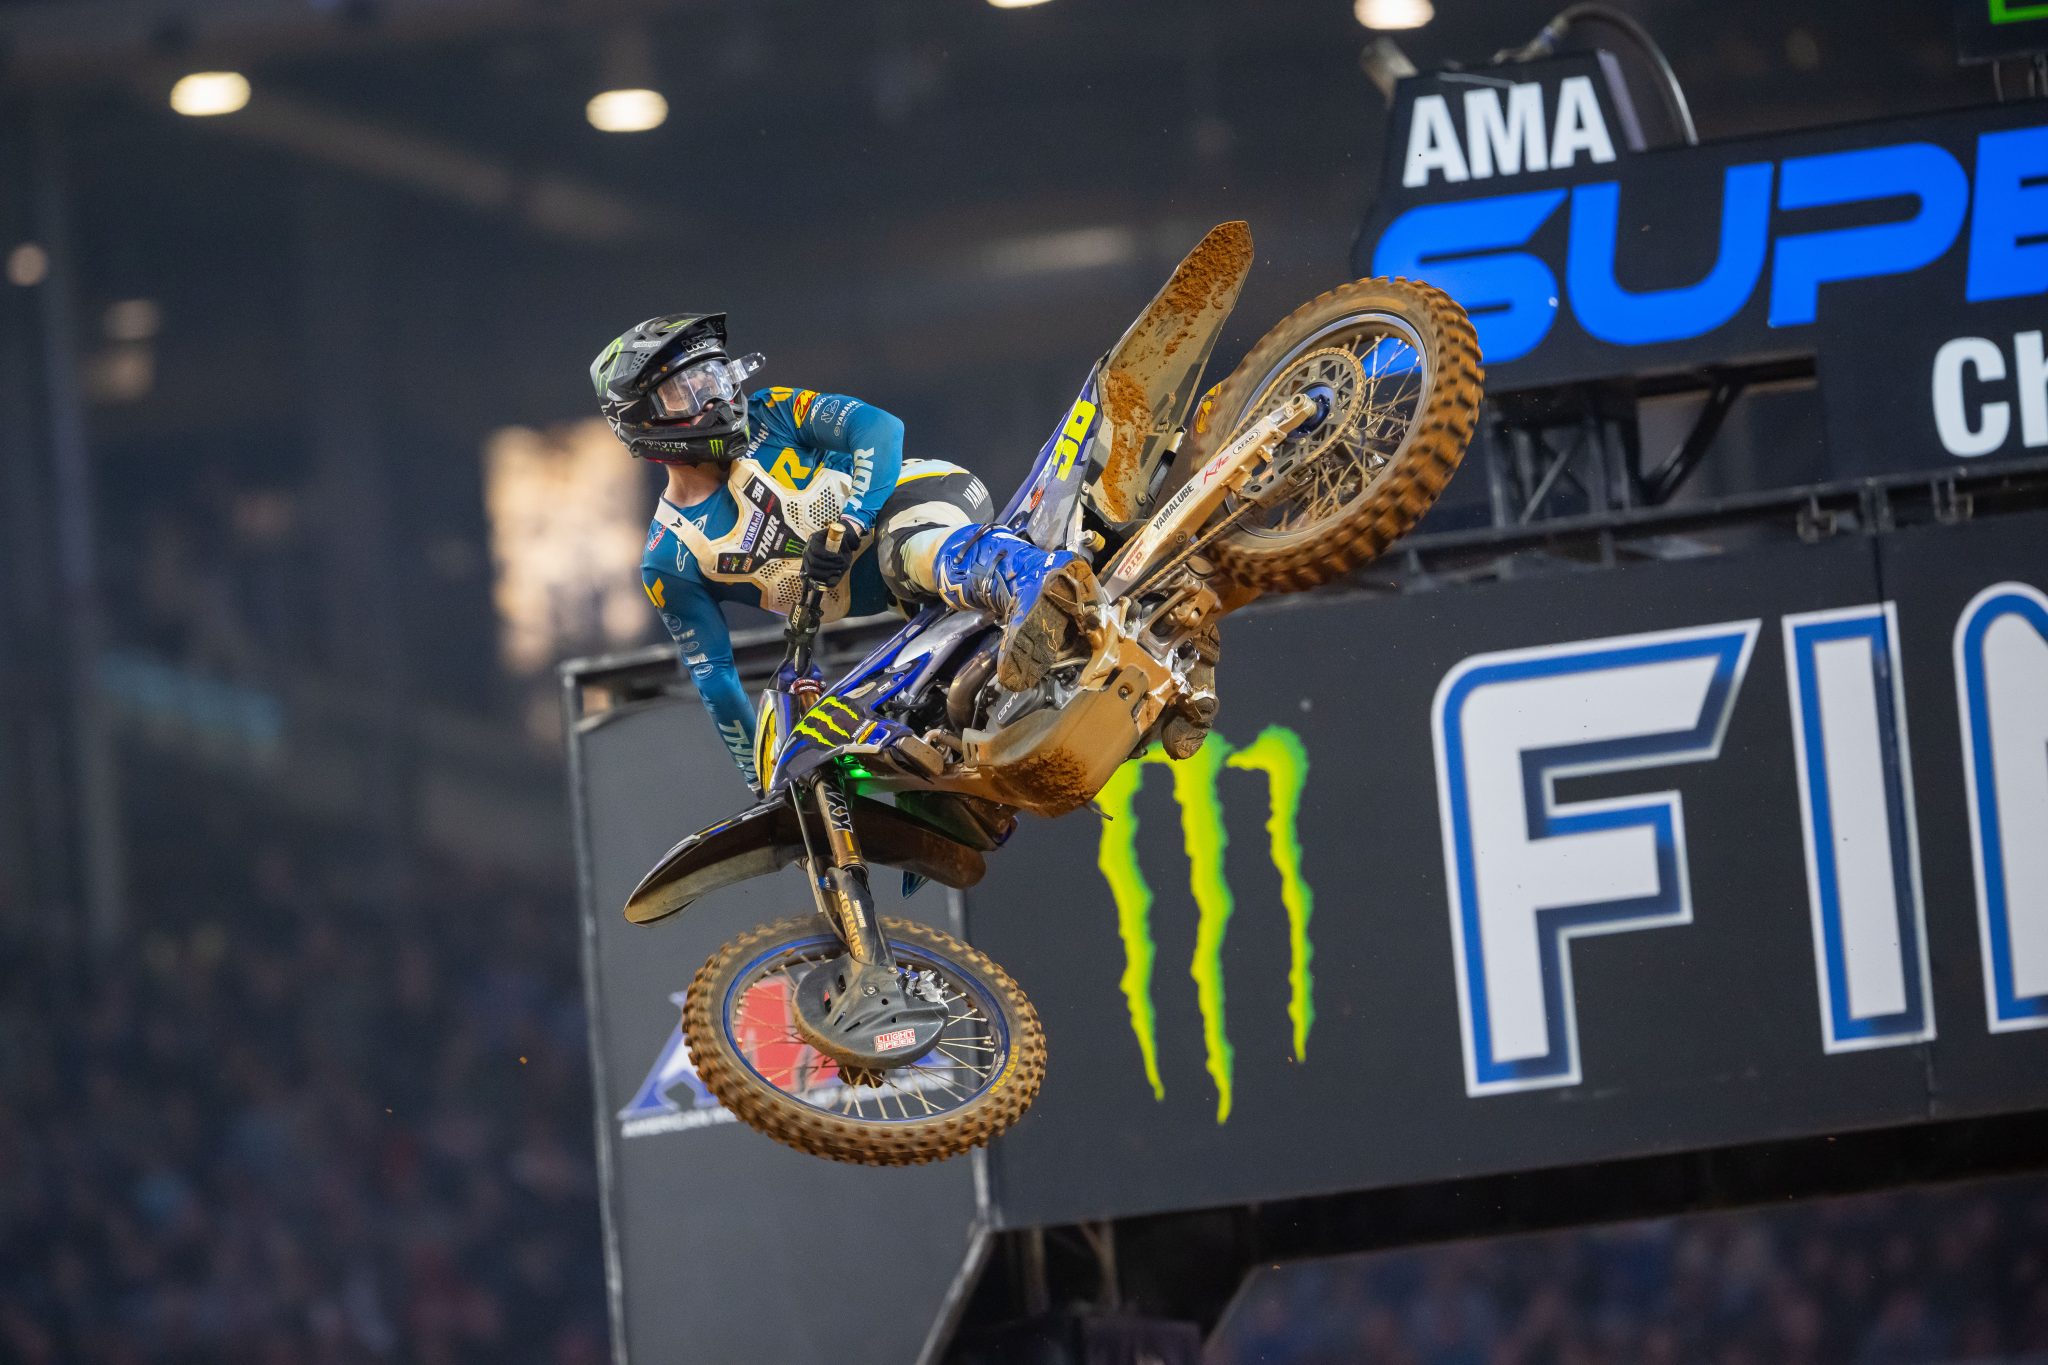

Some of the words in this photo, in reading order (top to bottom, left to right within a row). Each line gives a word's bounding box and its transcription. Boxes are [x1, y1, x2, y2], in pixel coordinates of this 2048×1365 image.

[1402, 76, 1617, 188] AMA
[836, 400, 859, 426] YAMAHA
[1237, 434, 1256, 451] AFAM
[751, 481, 766, 503] 38
[847, 446, 875, 512] HOR
[1153, 483, 1195, 531] YAMALUBE
[744, 511, 764, 545] YAMAHA
[755, 514, 780, 559] THOR
[838, 890, 865, 957] DUNLOP
[876, 1029, 915, 1043] LIGHT
[876, 1037, 916, 1052] SPEED
